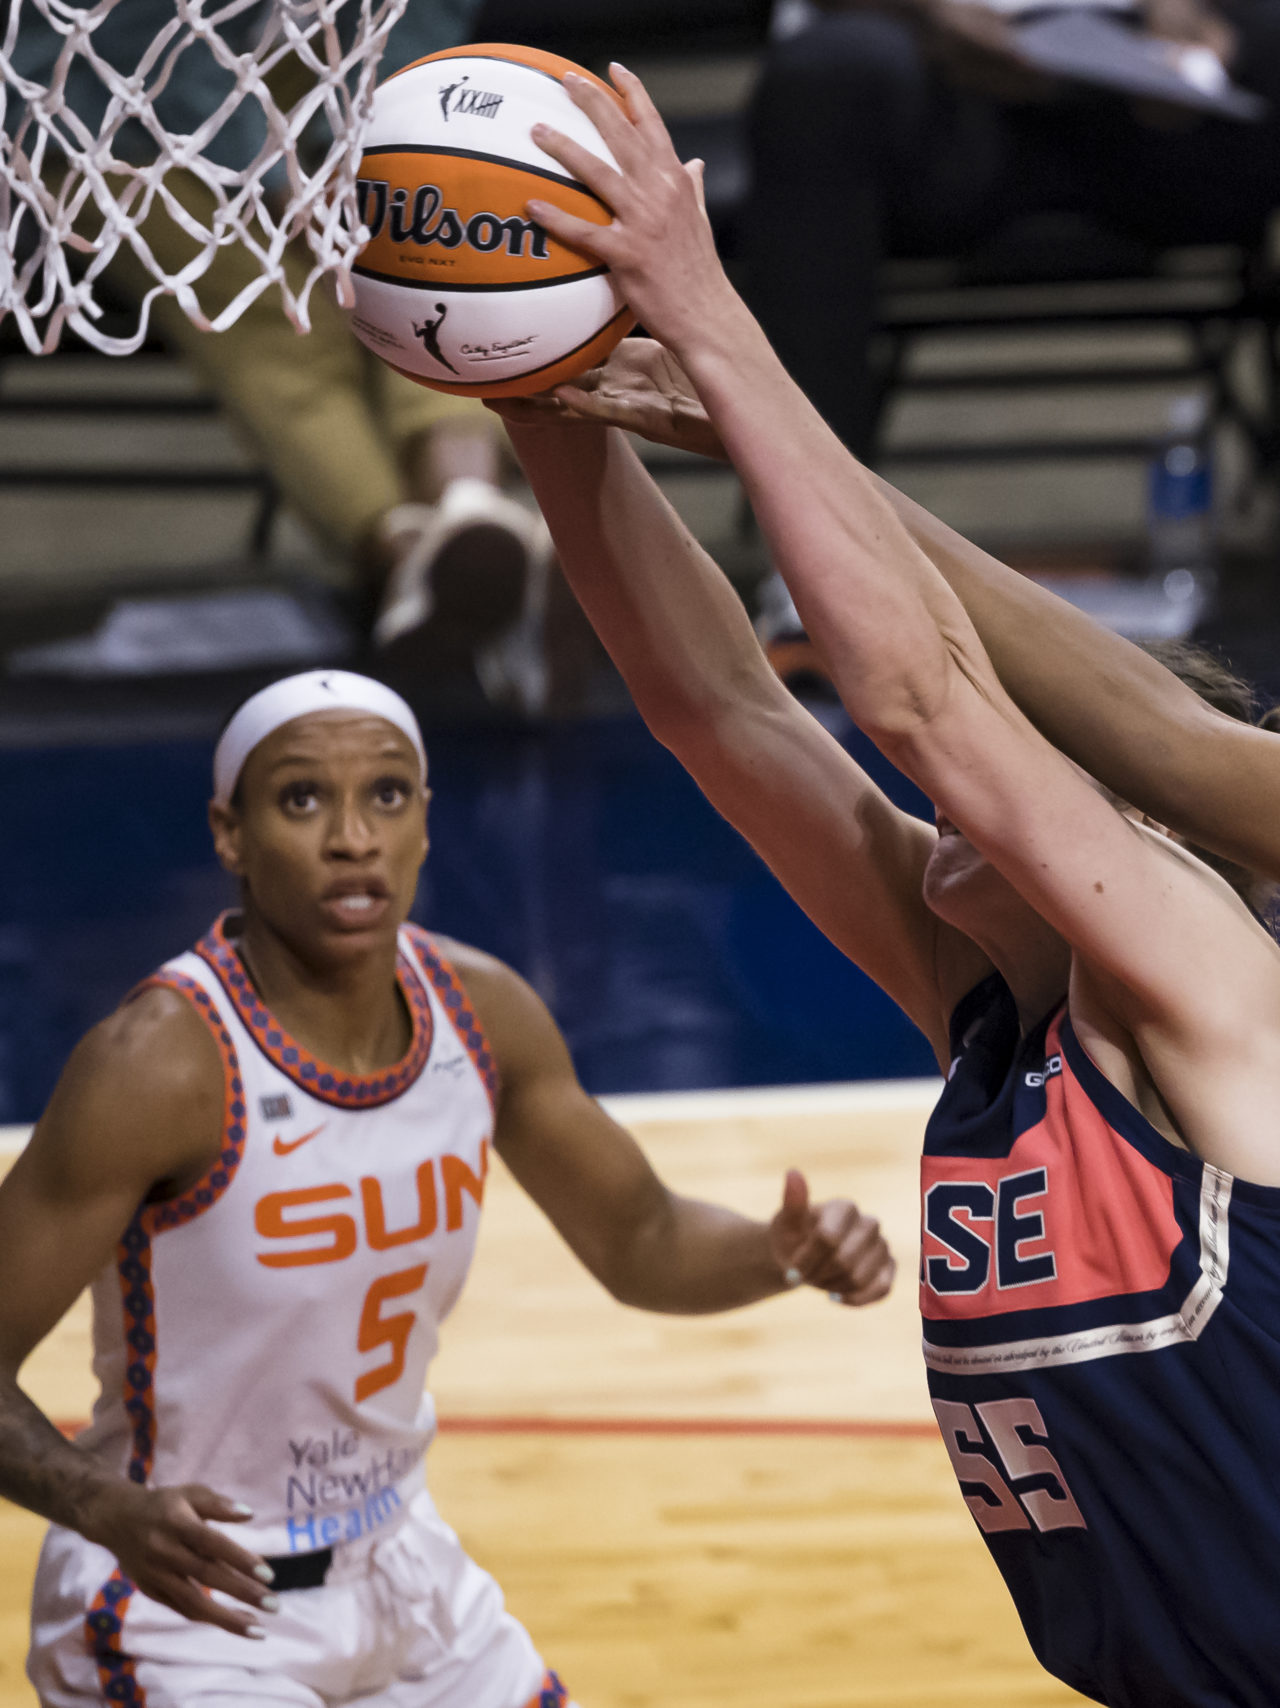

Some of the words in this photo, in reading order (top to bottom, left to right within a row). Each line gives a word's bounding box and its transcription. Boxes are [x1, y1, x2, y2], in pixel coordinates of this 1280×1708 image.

[339, 178, 550, 260] Wilson
[253, 1136, 489, 1268] SUN
[921, 1166, 1057, 1296] SE
[355, 1264, 428, 1403] 5
[288, 1428, 359, 1470] Yale
[930, 1398, 1089, 1533] 55
